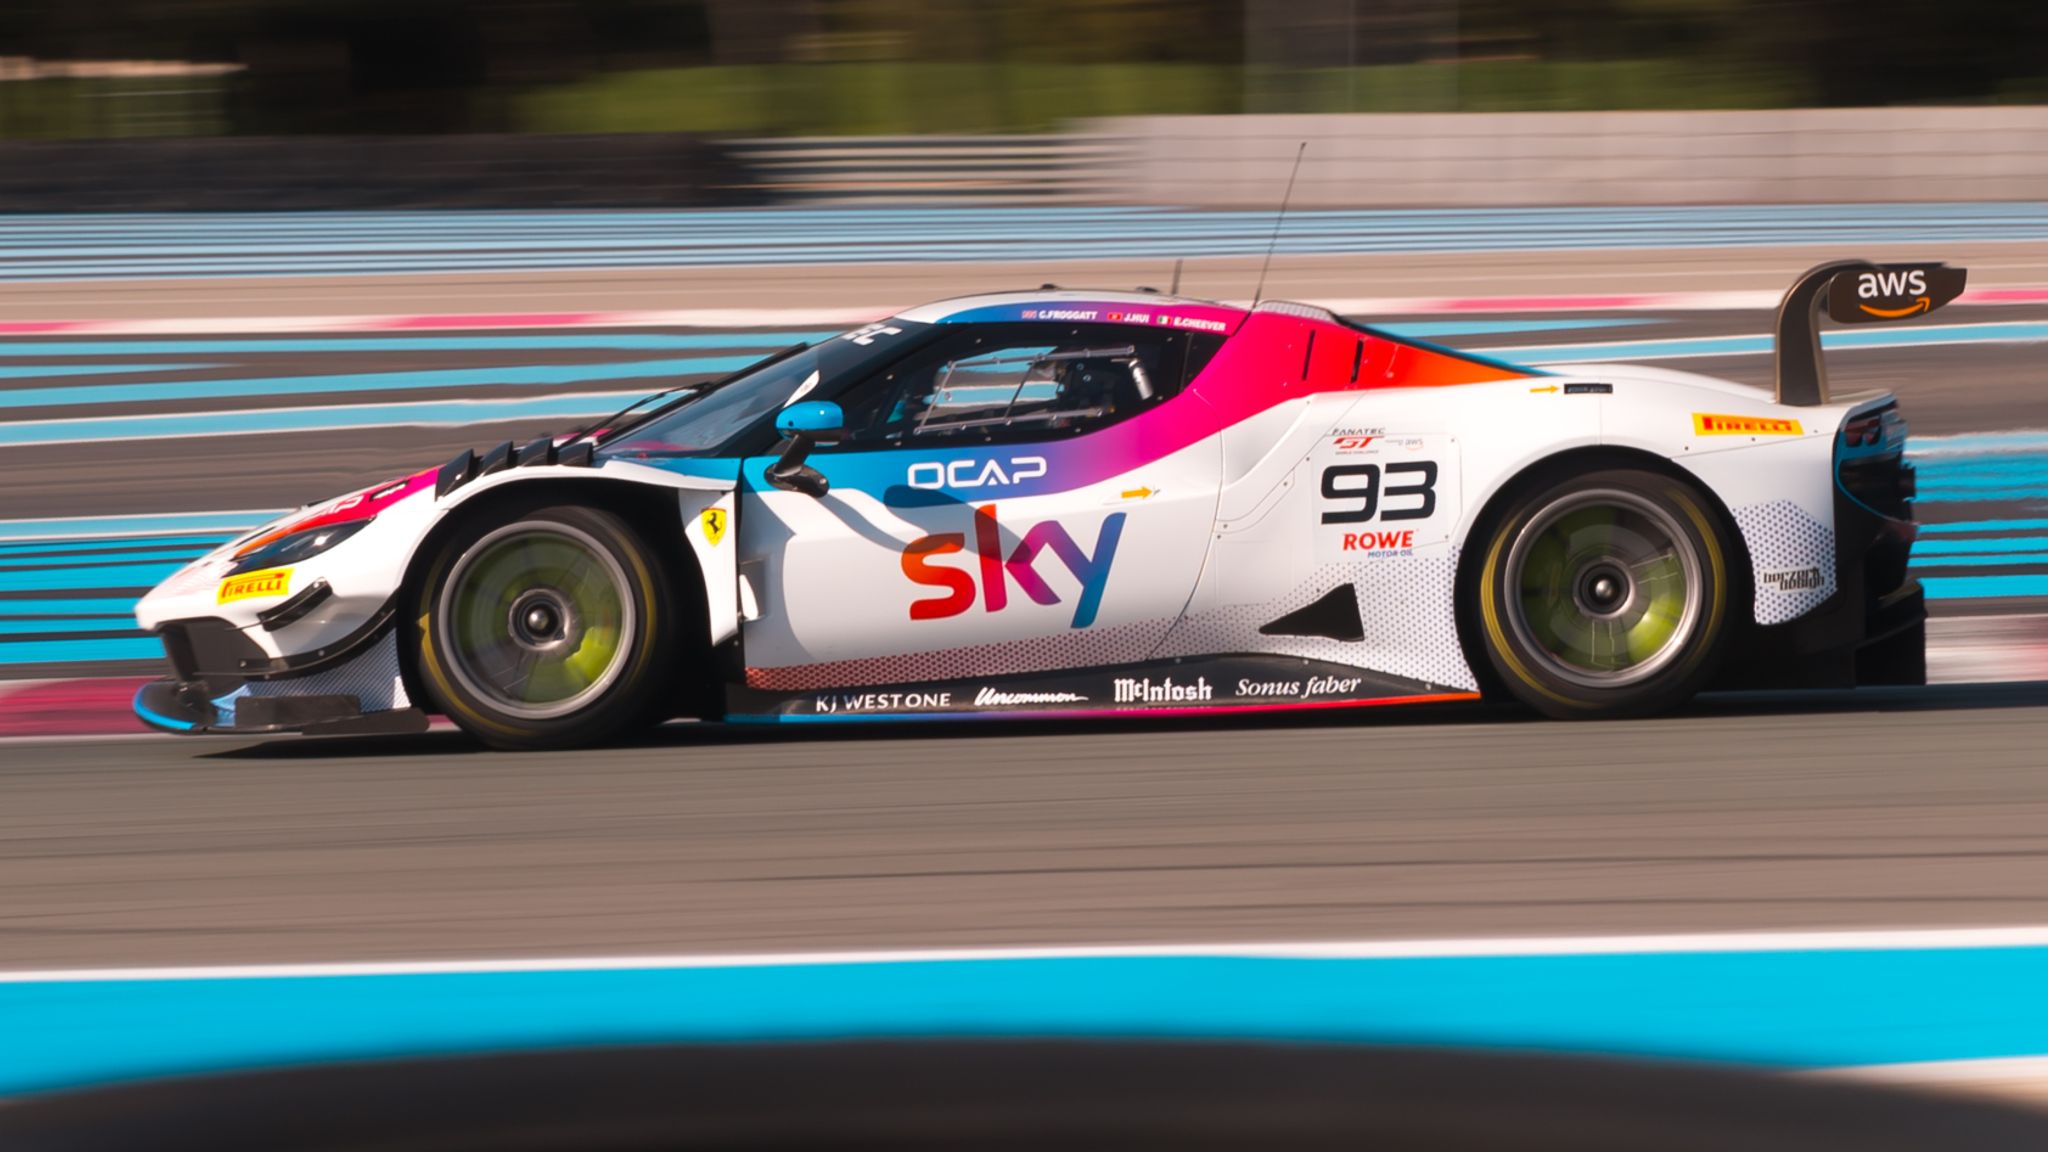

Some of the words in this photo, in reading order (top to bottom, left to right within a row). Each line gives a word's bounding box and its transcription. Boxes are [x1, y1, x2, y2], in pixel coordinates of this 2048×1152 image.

[1857, 269, 1927, 298] aws
[1702, 416, 1792, 431] PIRELLI
[907, 456, 1047, 489] OCAP
[1320, 460, 1438, 525] 93
[1342, 530, 1414, 551] ROWE
[900, 503, 1127, 629] sky
[221, 572, 285, 598] PIRELLI
[974, 687, 1089, 706] Uncommon
[1114, 677, 1213, 703] McIntosh
[1235, 678, 1300, 697] Sonus
[1300, 675, 1362, 699] faber
[815, 695, 838, 713] KJ
